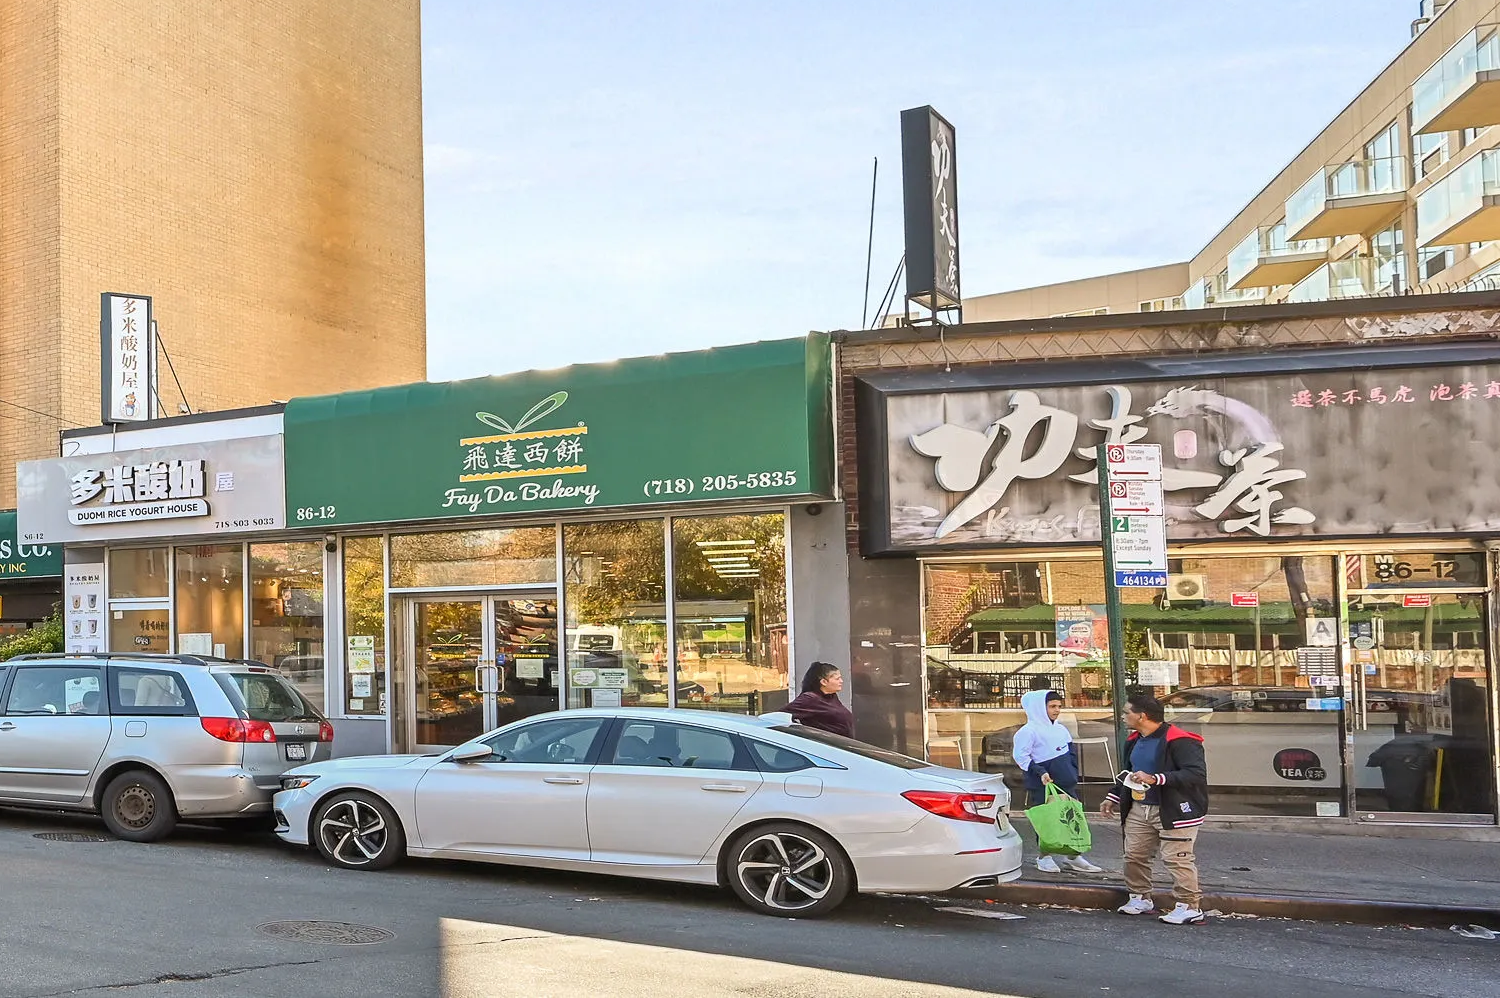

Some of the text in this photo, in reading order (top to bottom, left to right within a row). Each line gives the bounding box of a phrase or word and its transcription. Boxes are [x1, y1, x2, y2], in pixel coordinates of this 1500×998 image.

[121, 298, 138, 389] 多米酸奶屋
[1290, 386, 1415, 408] 選茶不馬虎
[463, 437, 584, 471] 飛達西餅
[643, 470, 798, 498] (718) 205-5835
[441, 479, 600, 513] Fay Da Bakery
[77, 503, 198, 521] DUOMI RICE YOGURT HOUSE
[296, 505, 336, 521] 86-12
[1116, 517, 1126, 531] 2
[8, 562, 27, 573] INC
[1122, 575, 1155, 586] 464134
[1312, 620, 1331, 638] A
[1281, 768, 1303, 777] TEA
